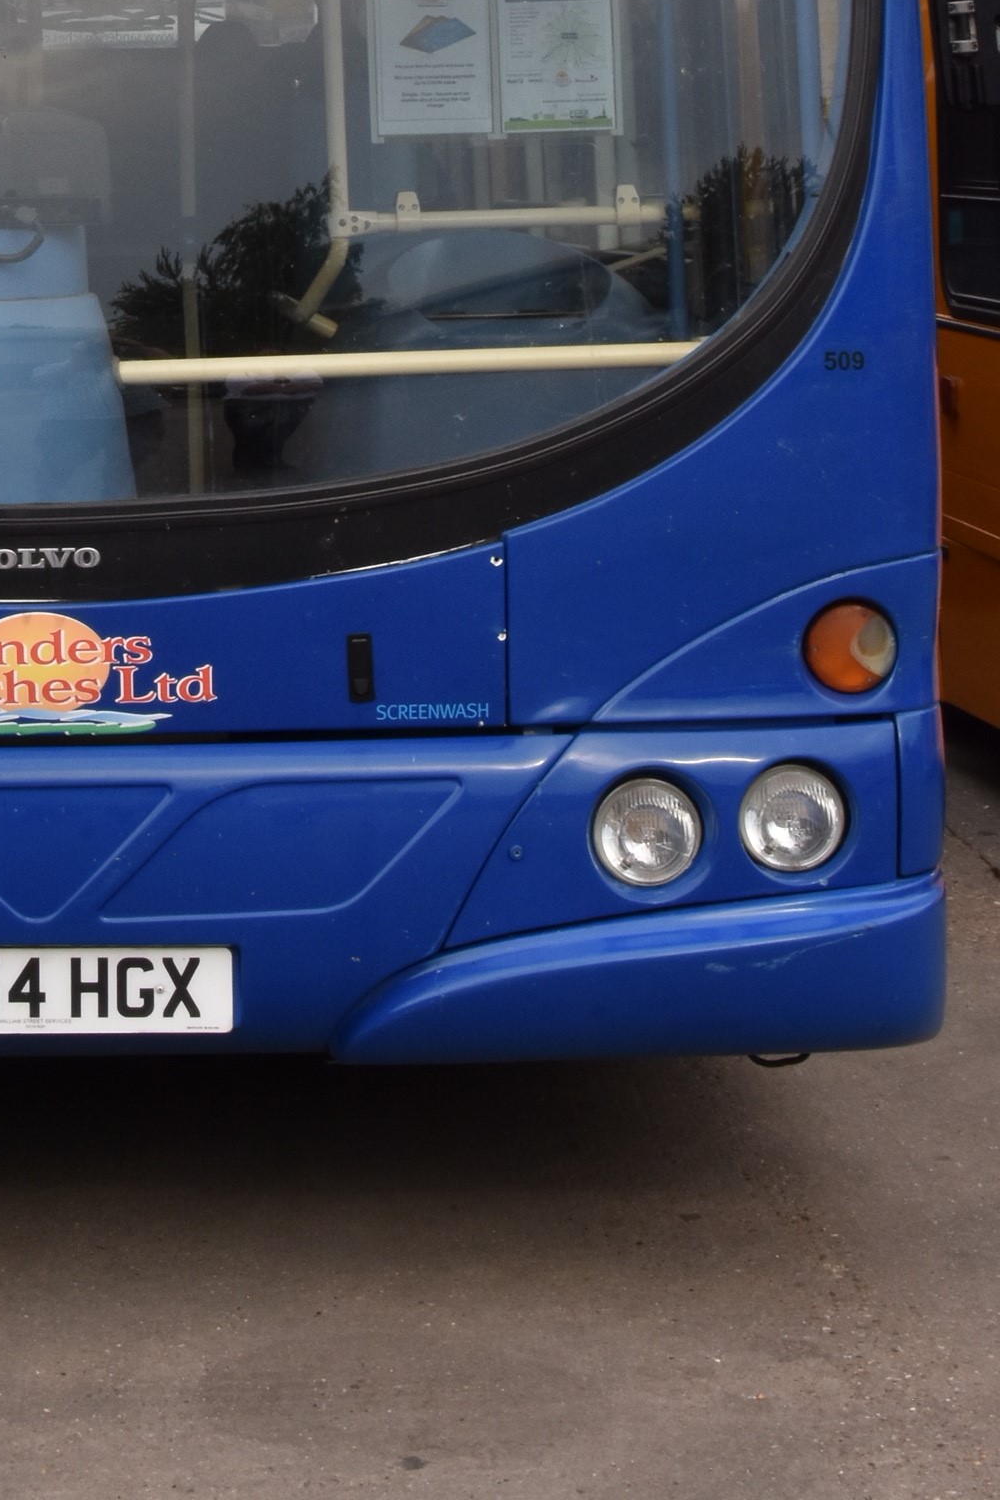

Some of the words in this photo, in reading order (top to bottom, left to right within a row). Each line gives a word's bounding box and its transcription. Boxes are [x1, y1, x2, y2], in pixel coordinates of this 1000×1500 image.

[824, 351, 865, 371] 509
[114, 664, 217, 705] Ltd
[375, 702, 489, 721] SCREENWASH
[69, 956, 201, 1018] HGX
